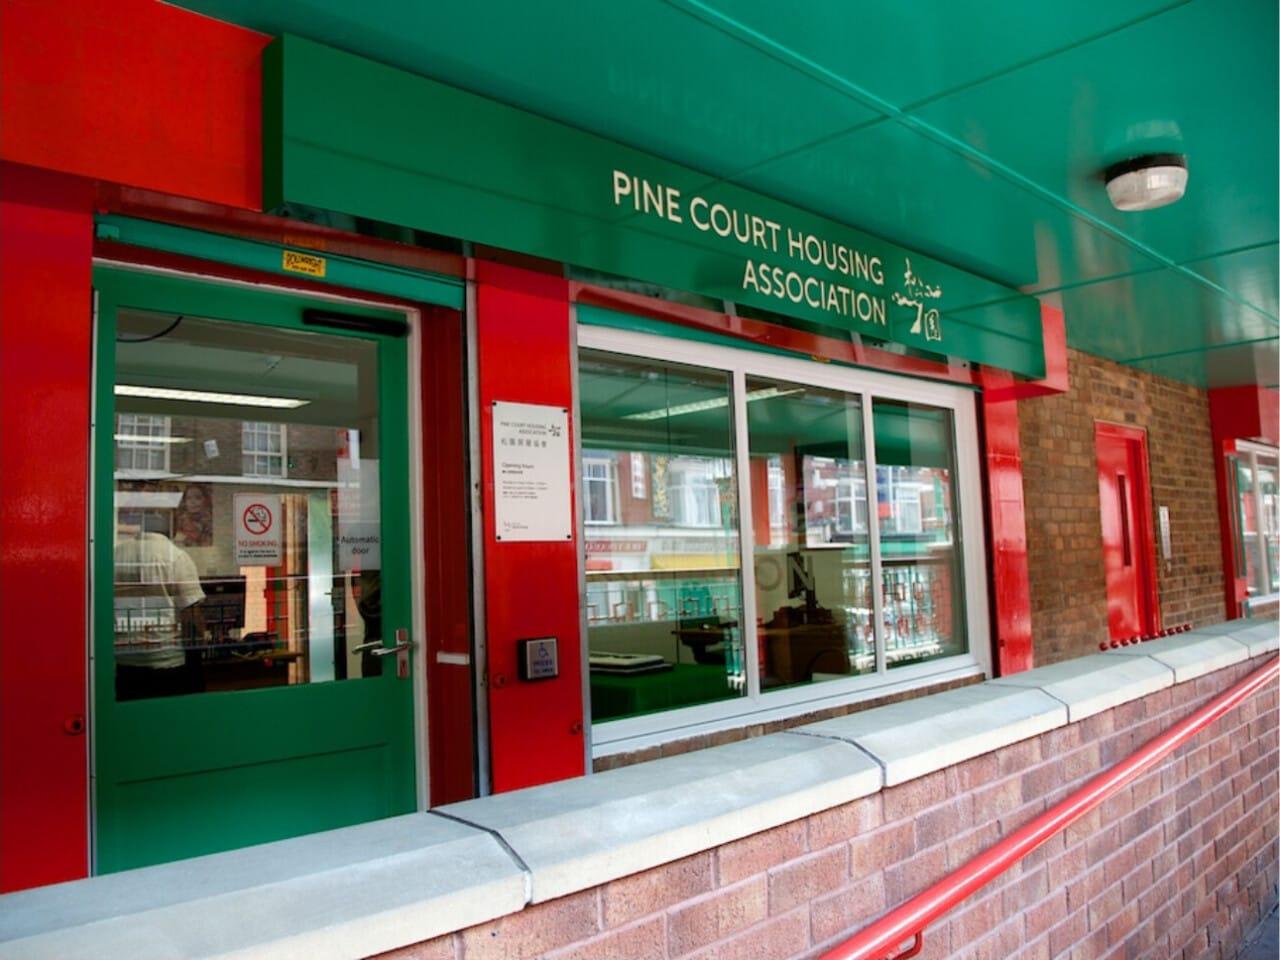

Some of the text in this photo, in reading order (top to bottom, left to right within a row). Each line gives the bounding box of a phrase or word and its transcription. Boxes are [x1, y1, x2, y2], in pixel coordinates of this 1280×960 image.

[613, 170, 884, 286] PINE COURT HOUSING
[743, 259, 887, 327] ASSOCIATION
[341, 535, 380, 544] Automatic
